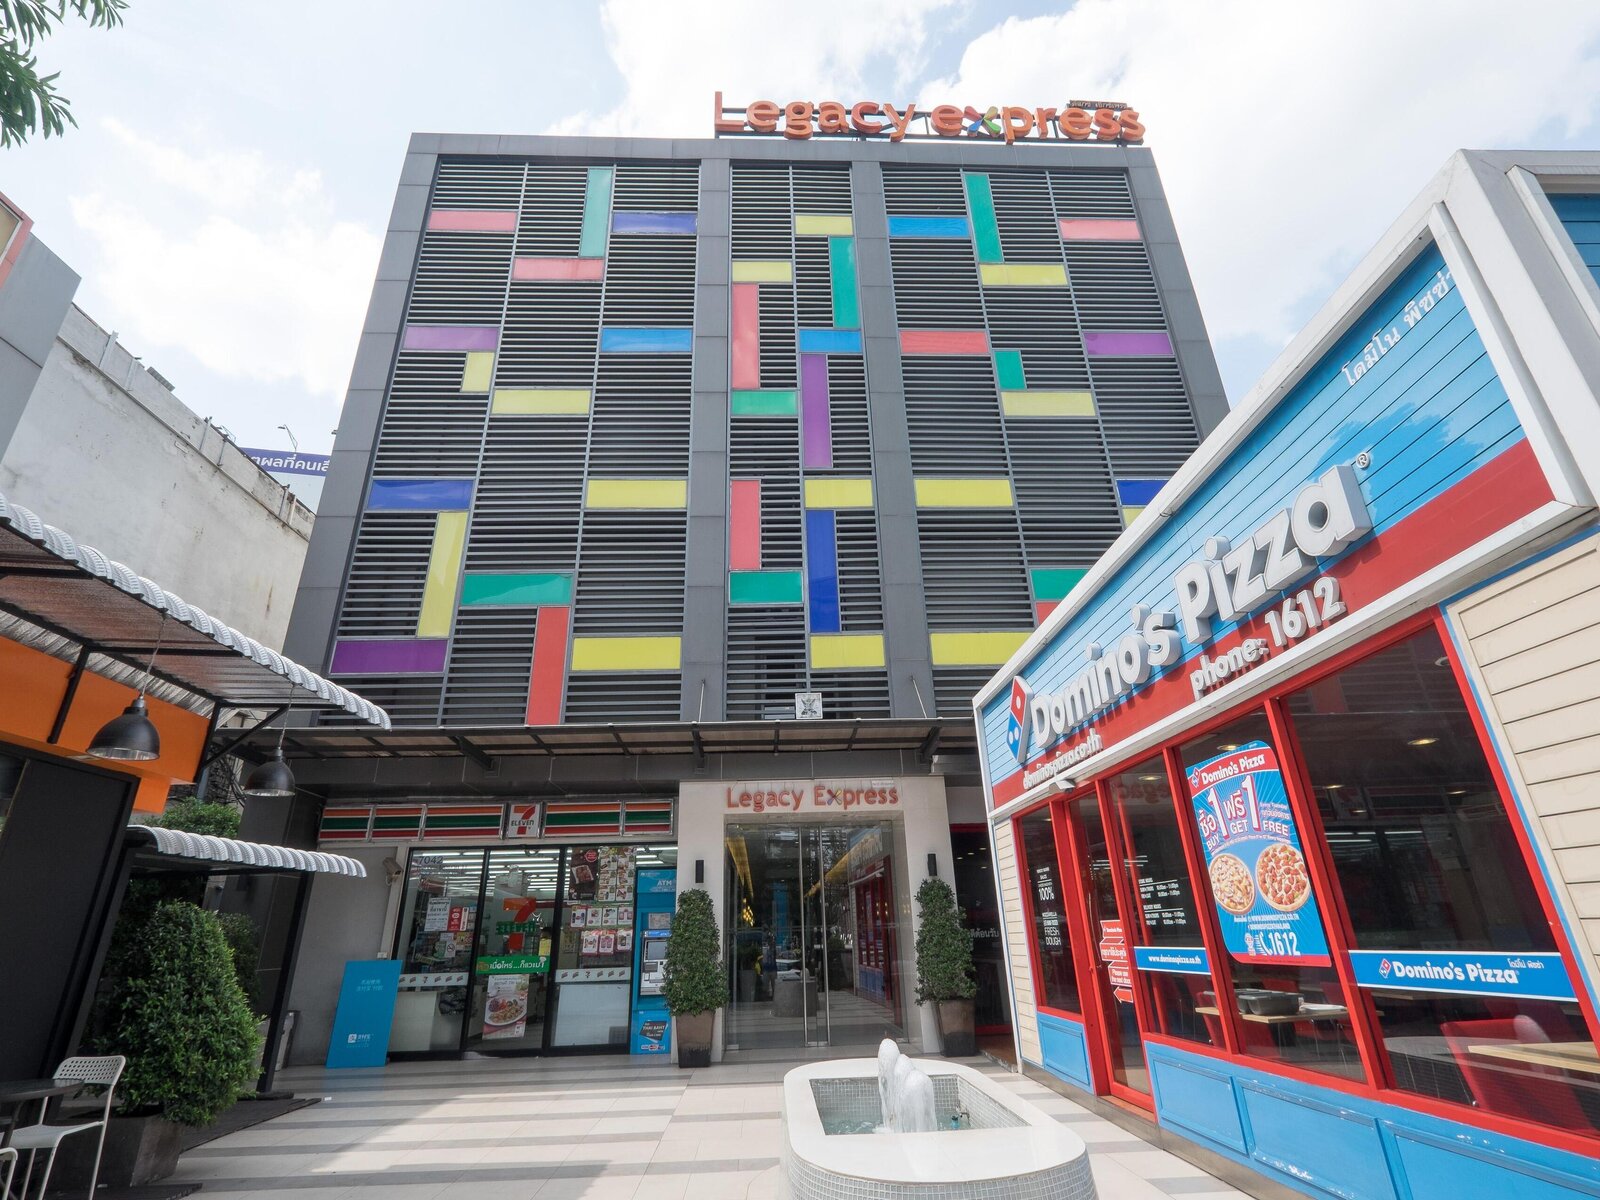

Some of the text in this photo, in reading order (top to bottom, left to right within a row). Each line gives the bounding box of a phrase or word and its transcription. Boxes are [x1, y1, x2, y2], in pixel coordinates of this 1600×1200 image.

[714, 91, 1146, 145] Legacy express
[1342, 327, 1401, 386] โดมิโน
[1030, 465, 1373, 749] Domino's Pizza
[1264, 576, 1347, 646] 1612
[1023, 727, 1103, 790] dominospizza.co.th
[1201, 754, 1265, 785] Domino's Pizza
[726, 785, 898, 812] Legacy Express
[1206, 833, 1220, 850] BUY
[1229, 819, 1248, 835] GET
[1262, 820, 1289, 836] FREE
[419, 856, 443, 865] 7042
[657, 879, 673, 887] ATM
[1038, 886, 1054, 900] 100%
[1044, 927, 1060, 936] FRESH
[1045, 937, 1061, 945] DOUGH
[1268, 931, 1300, 956] 1612
[1392, 960, 1518, 983] Domino's Pizza
